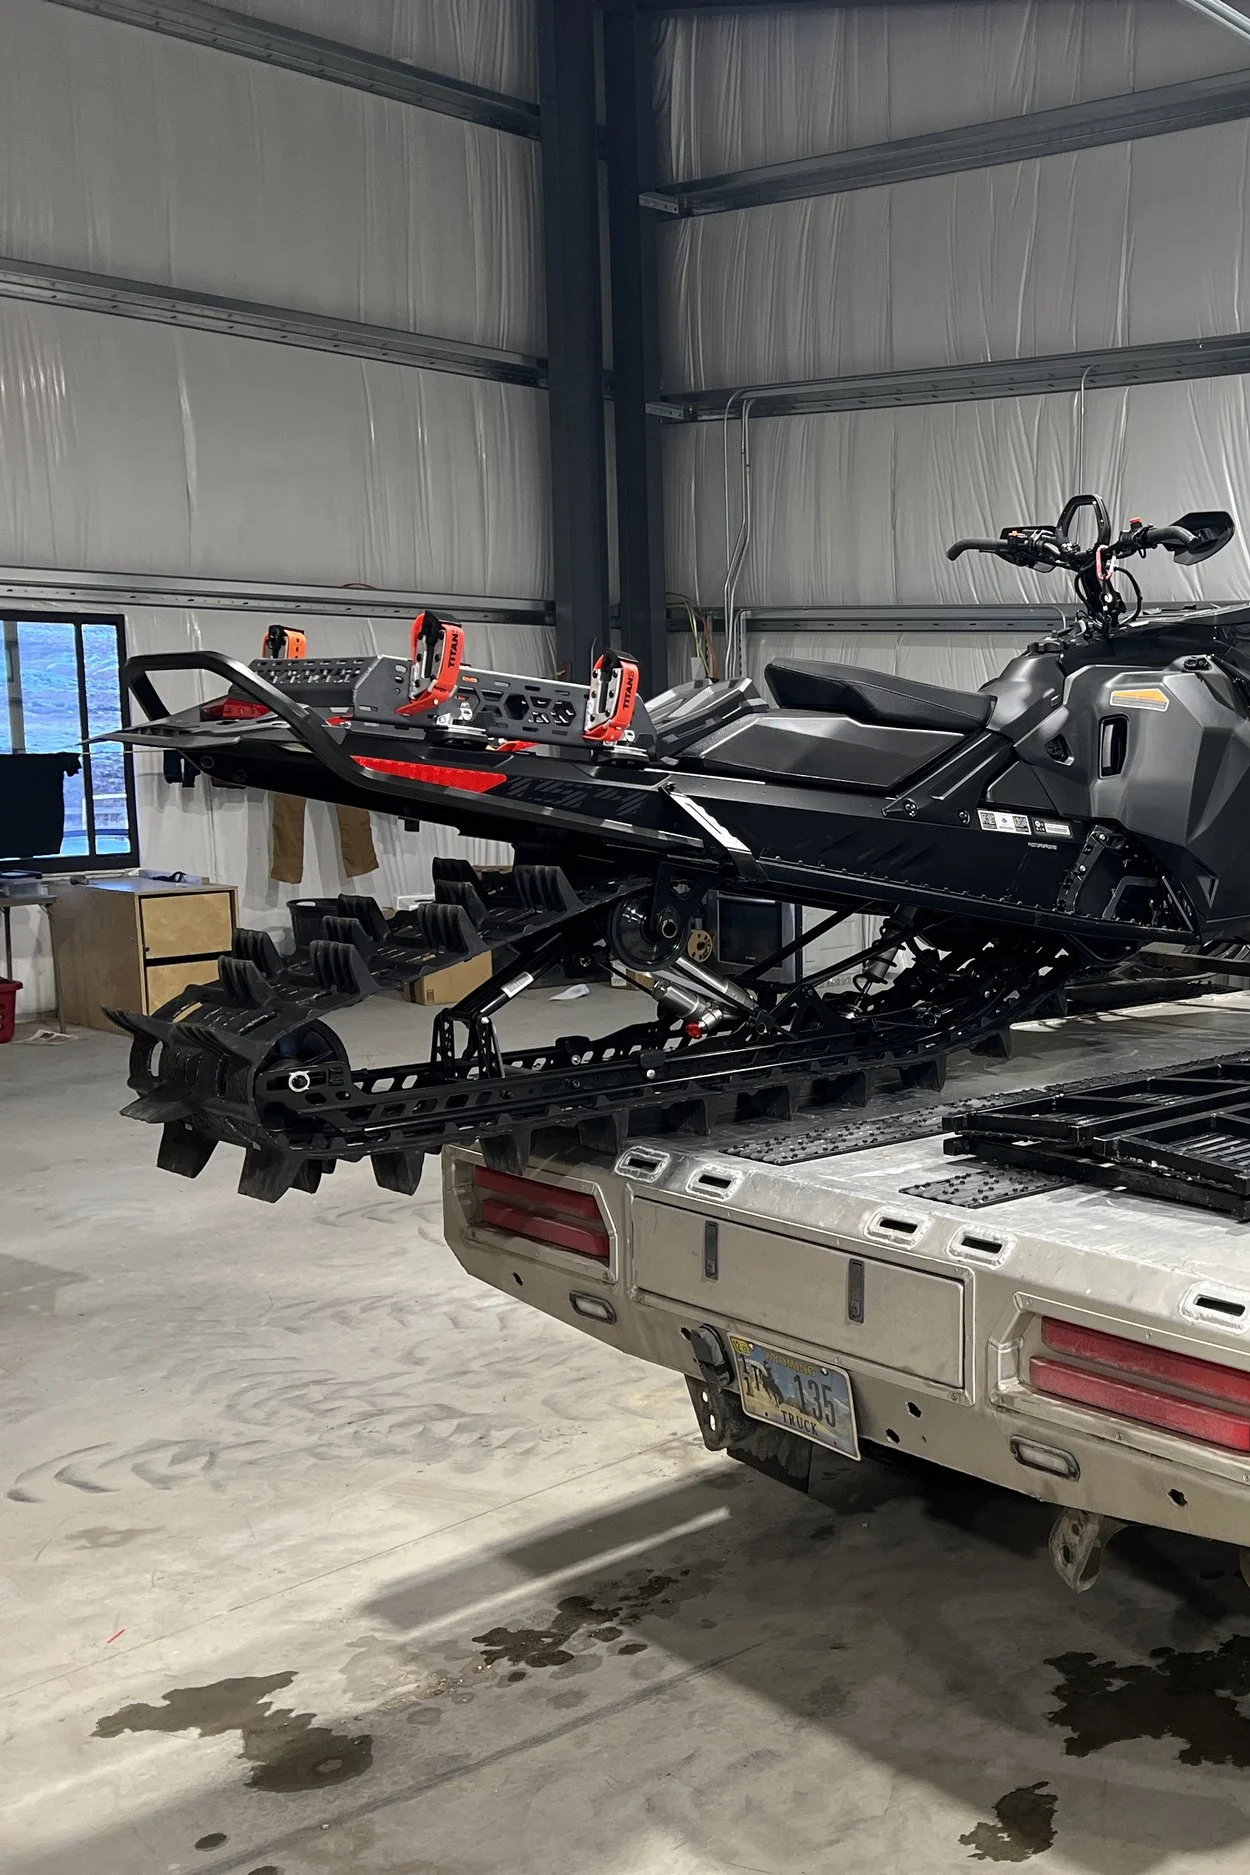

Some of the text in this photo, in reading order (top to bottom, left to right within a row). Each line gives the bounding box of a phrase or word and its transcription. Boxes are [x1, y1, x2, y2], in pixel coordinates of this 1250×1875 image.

[763, 1350, 817, 1378] WYOMING
[794, 1374, 837, 1428] 135
[781, 1409, 819, 1437] TRUCK
